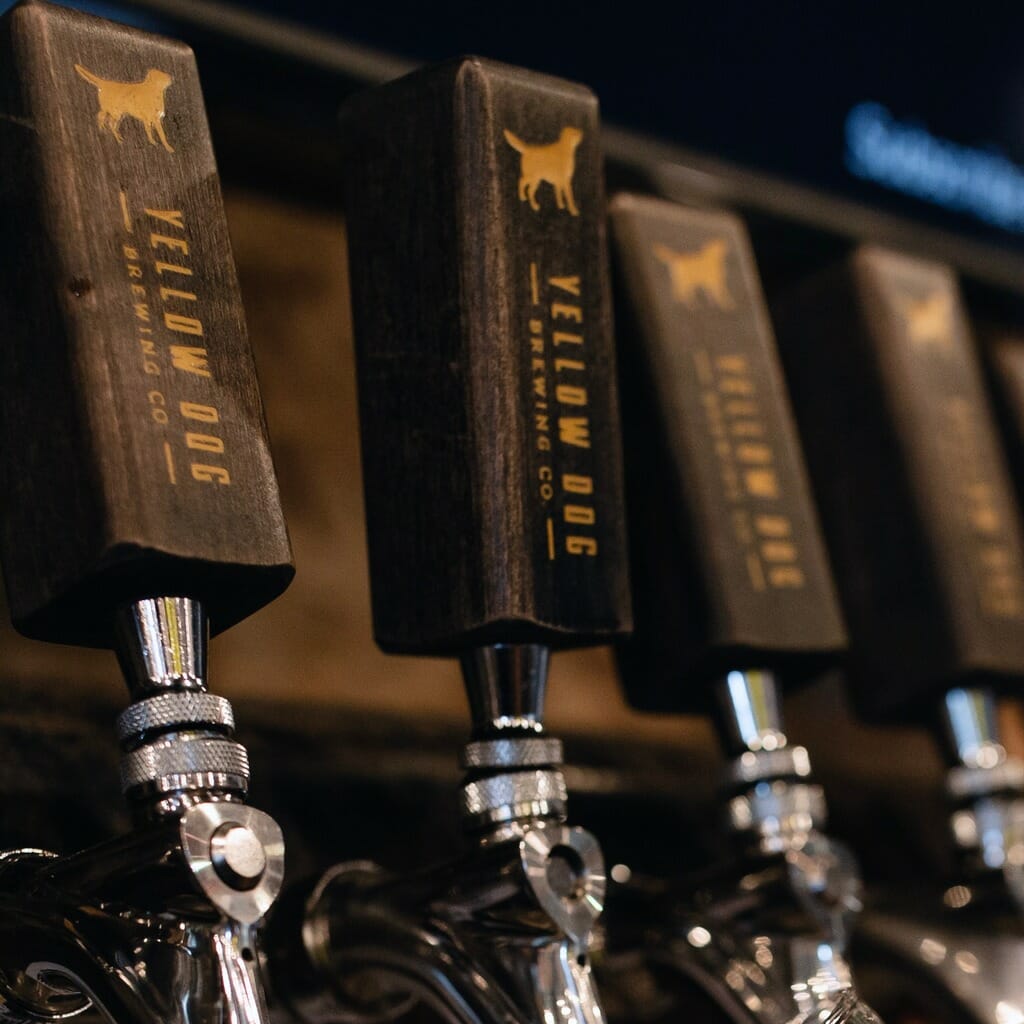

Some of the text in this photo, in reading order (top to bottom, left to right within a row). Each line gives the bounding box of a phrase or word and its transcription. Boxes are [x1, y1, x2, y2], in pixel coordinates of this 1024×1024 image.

[123, 244, 161, 376] BREWING
[144, 207, 231, 486] YELLOW DOG
[529, 318, 552, 451] BREWING
[548, 275, 598, 557] YELLOW DOG
